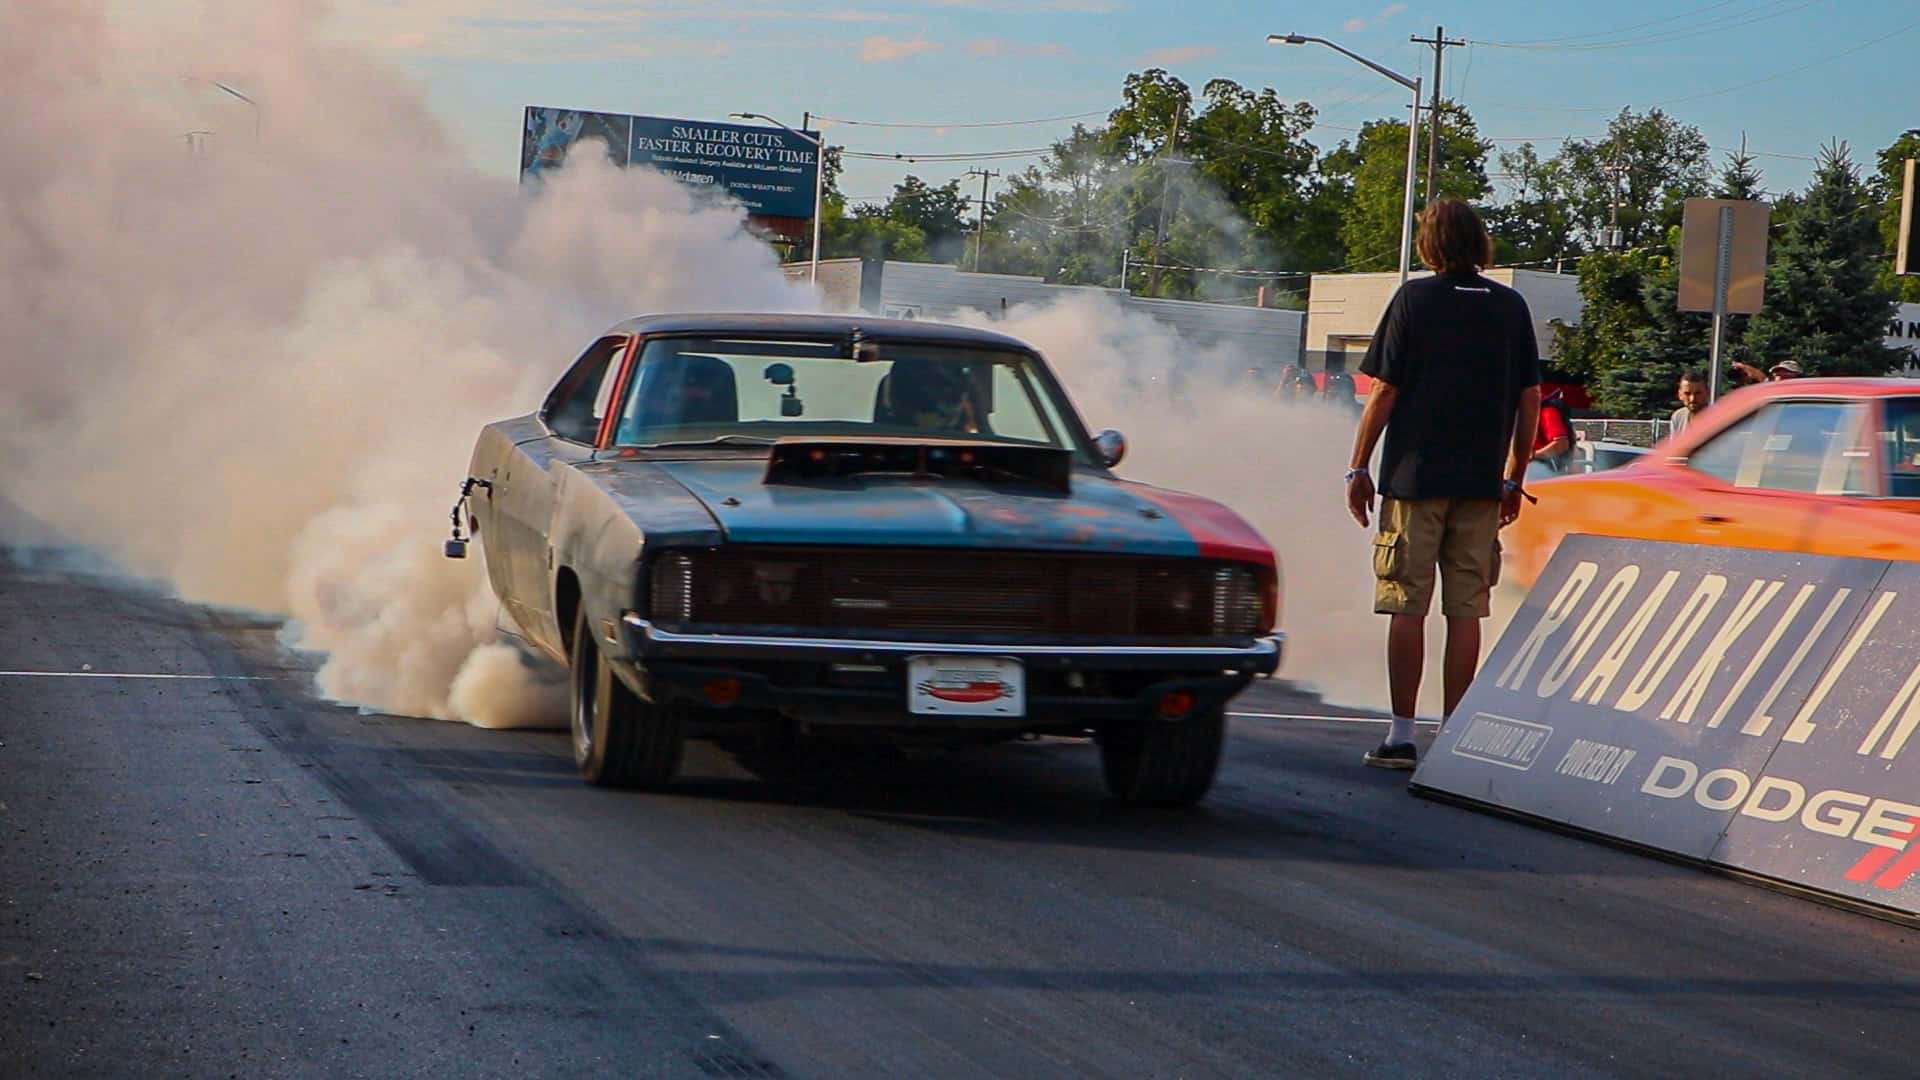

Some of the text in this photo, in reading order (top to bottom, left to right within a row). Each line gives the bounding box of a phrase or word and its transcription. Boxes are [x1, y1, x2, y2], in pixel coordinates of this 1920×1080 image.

[639, 137, 816, 165] FASTER RECOVERY TIME.
[672, 126, 785, 148] SMALLER CUTS.
[1496, 561, 1897, 745] ROADKILL
[1555, 738, 1637, 785] POWERED BY
[1641, 756, 1920, 851] DODGE
